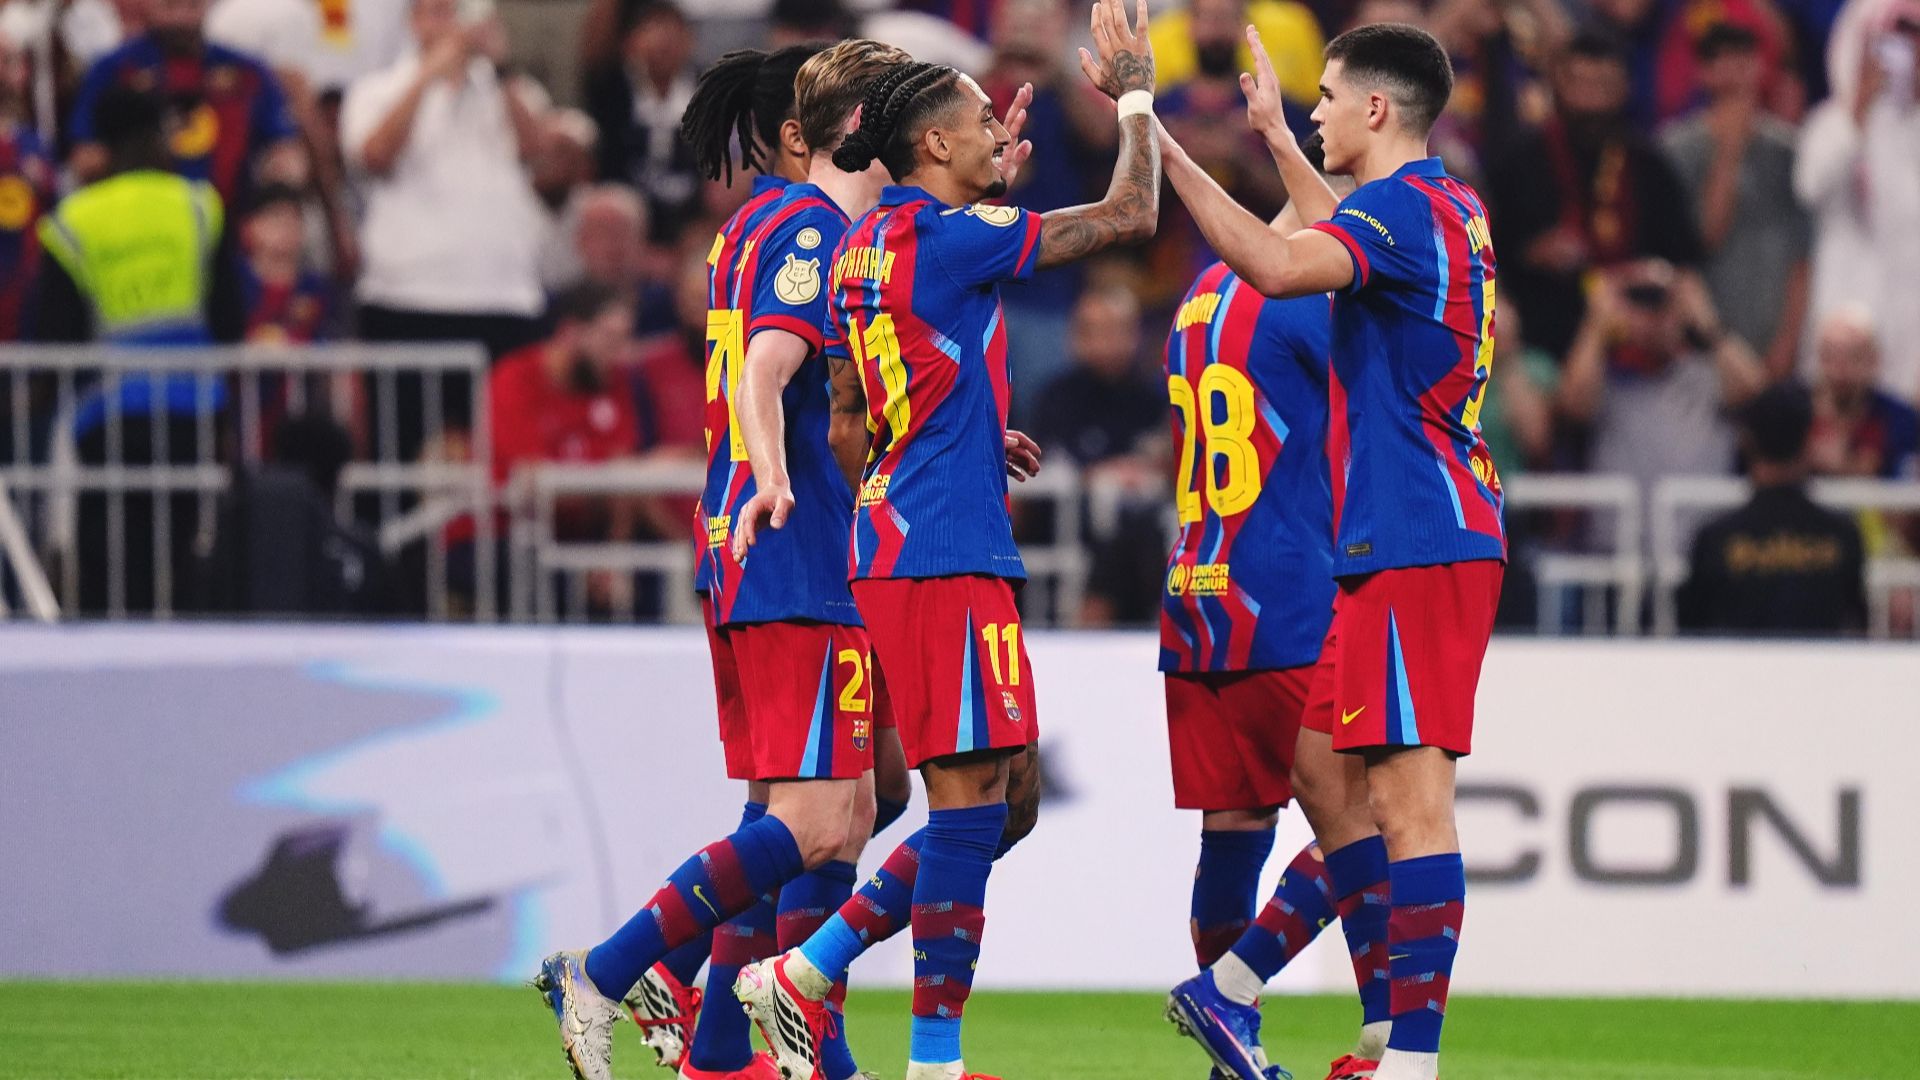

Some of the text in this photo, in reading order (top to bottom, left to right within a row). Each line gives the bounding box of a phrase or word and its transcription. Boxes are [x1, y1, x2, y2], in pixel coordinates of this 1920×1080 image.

[1168, 363, 1262, 527] 28
[1188, 577, 1229, 591] ACNUR
[1191, 563, 1230, 577] UNHCR
[982, 623, 1020, 686] 11
